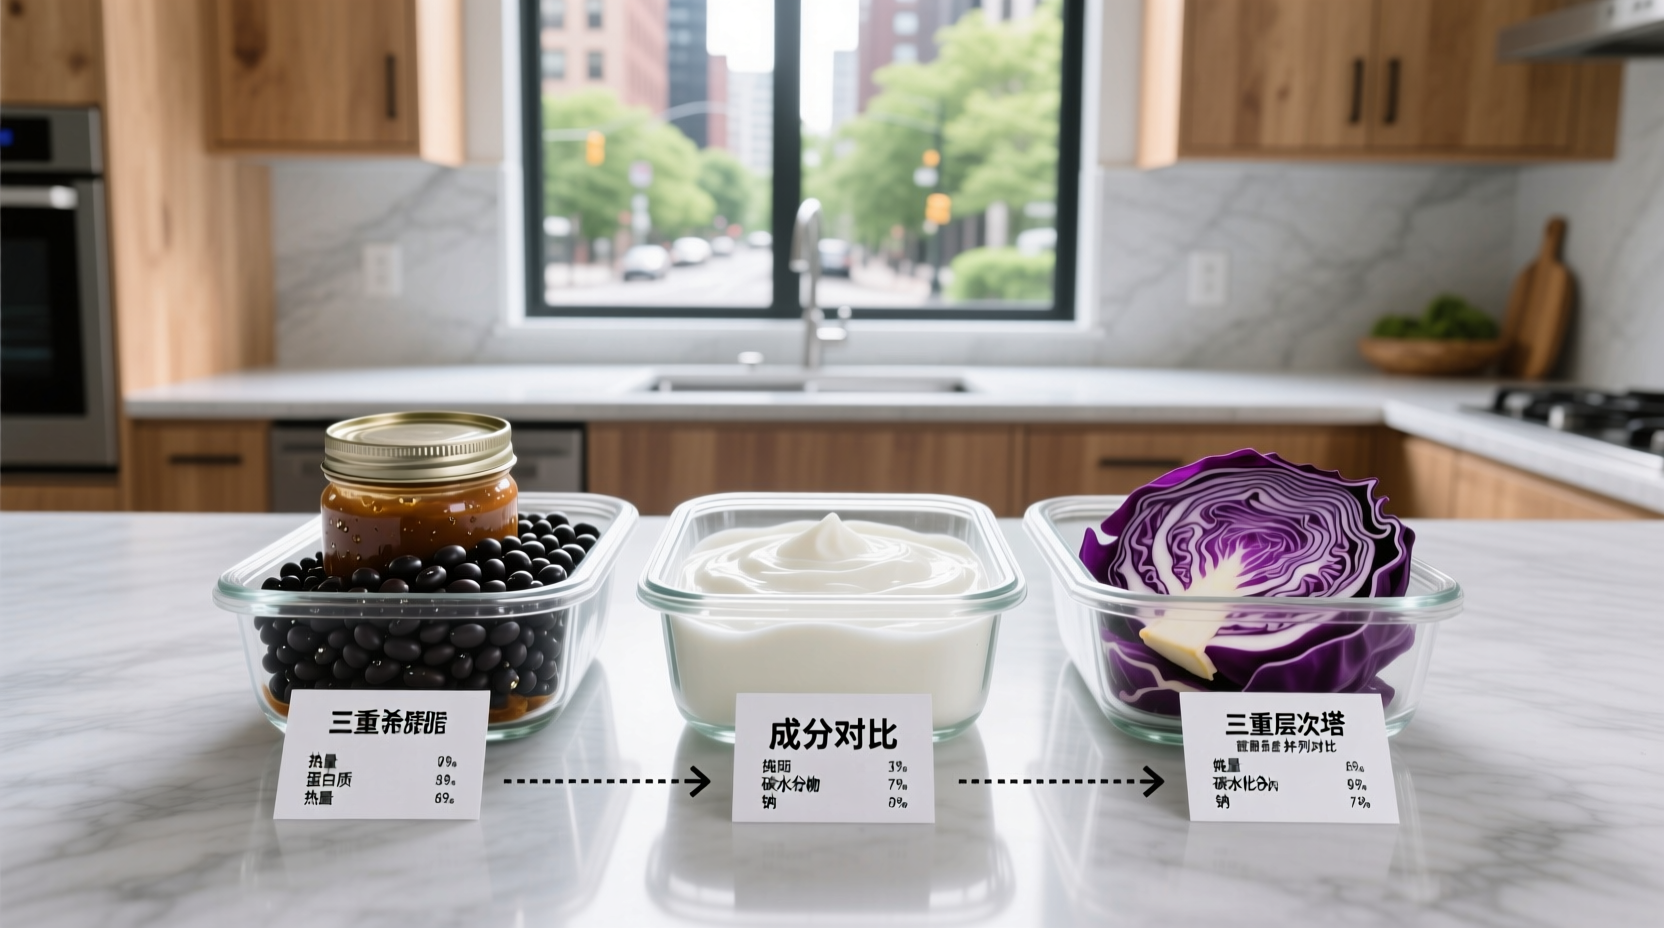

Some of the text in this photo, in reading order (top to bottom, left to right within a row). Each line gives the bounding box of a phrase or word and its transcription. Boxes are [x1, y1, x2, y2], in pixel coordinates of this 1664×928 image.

[769, 717, 897, 750] 成分对比
[1226, 710, 1345, 736] 三重层次塔
